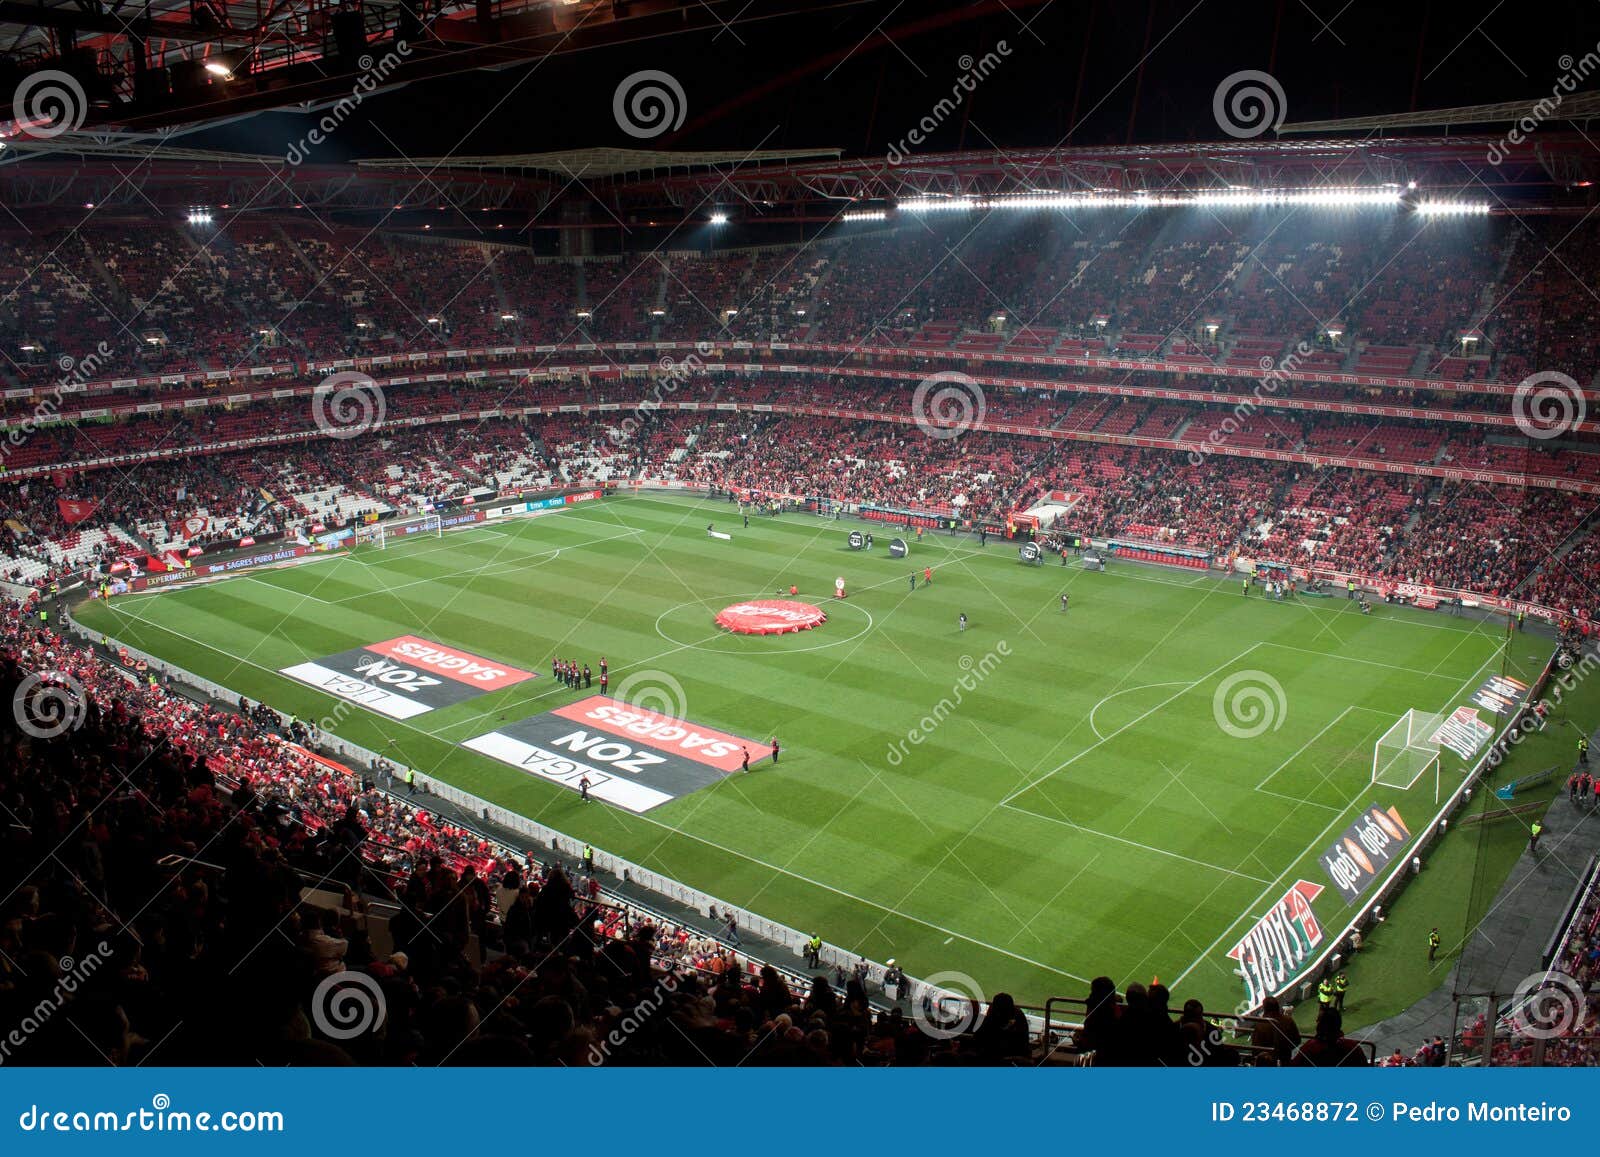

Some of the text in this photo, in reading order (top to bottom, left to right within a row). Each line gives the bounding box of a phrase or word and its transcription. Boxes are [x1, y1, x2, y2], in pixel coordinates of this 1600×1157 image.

[353, 660, 442, 692] ZON
[392, 642, 507, 681] SAGRES
[323, 675, 391, 703] LIGA
[585, 706, 741, 758] SAGRES
[521, 750, 613, 788] LIGA
[551, 730, 667, 773] ZON
